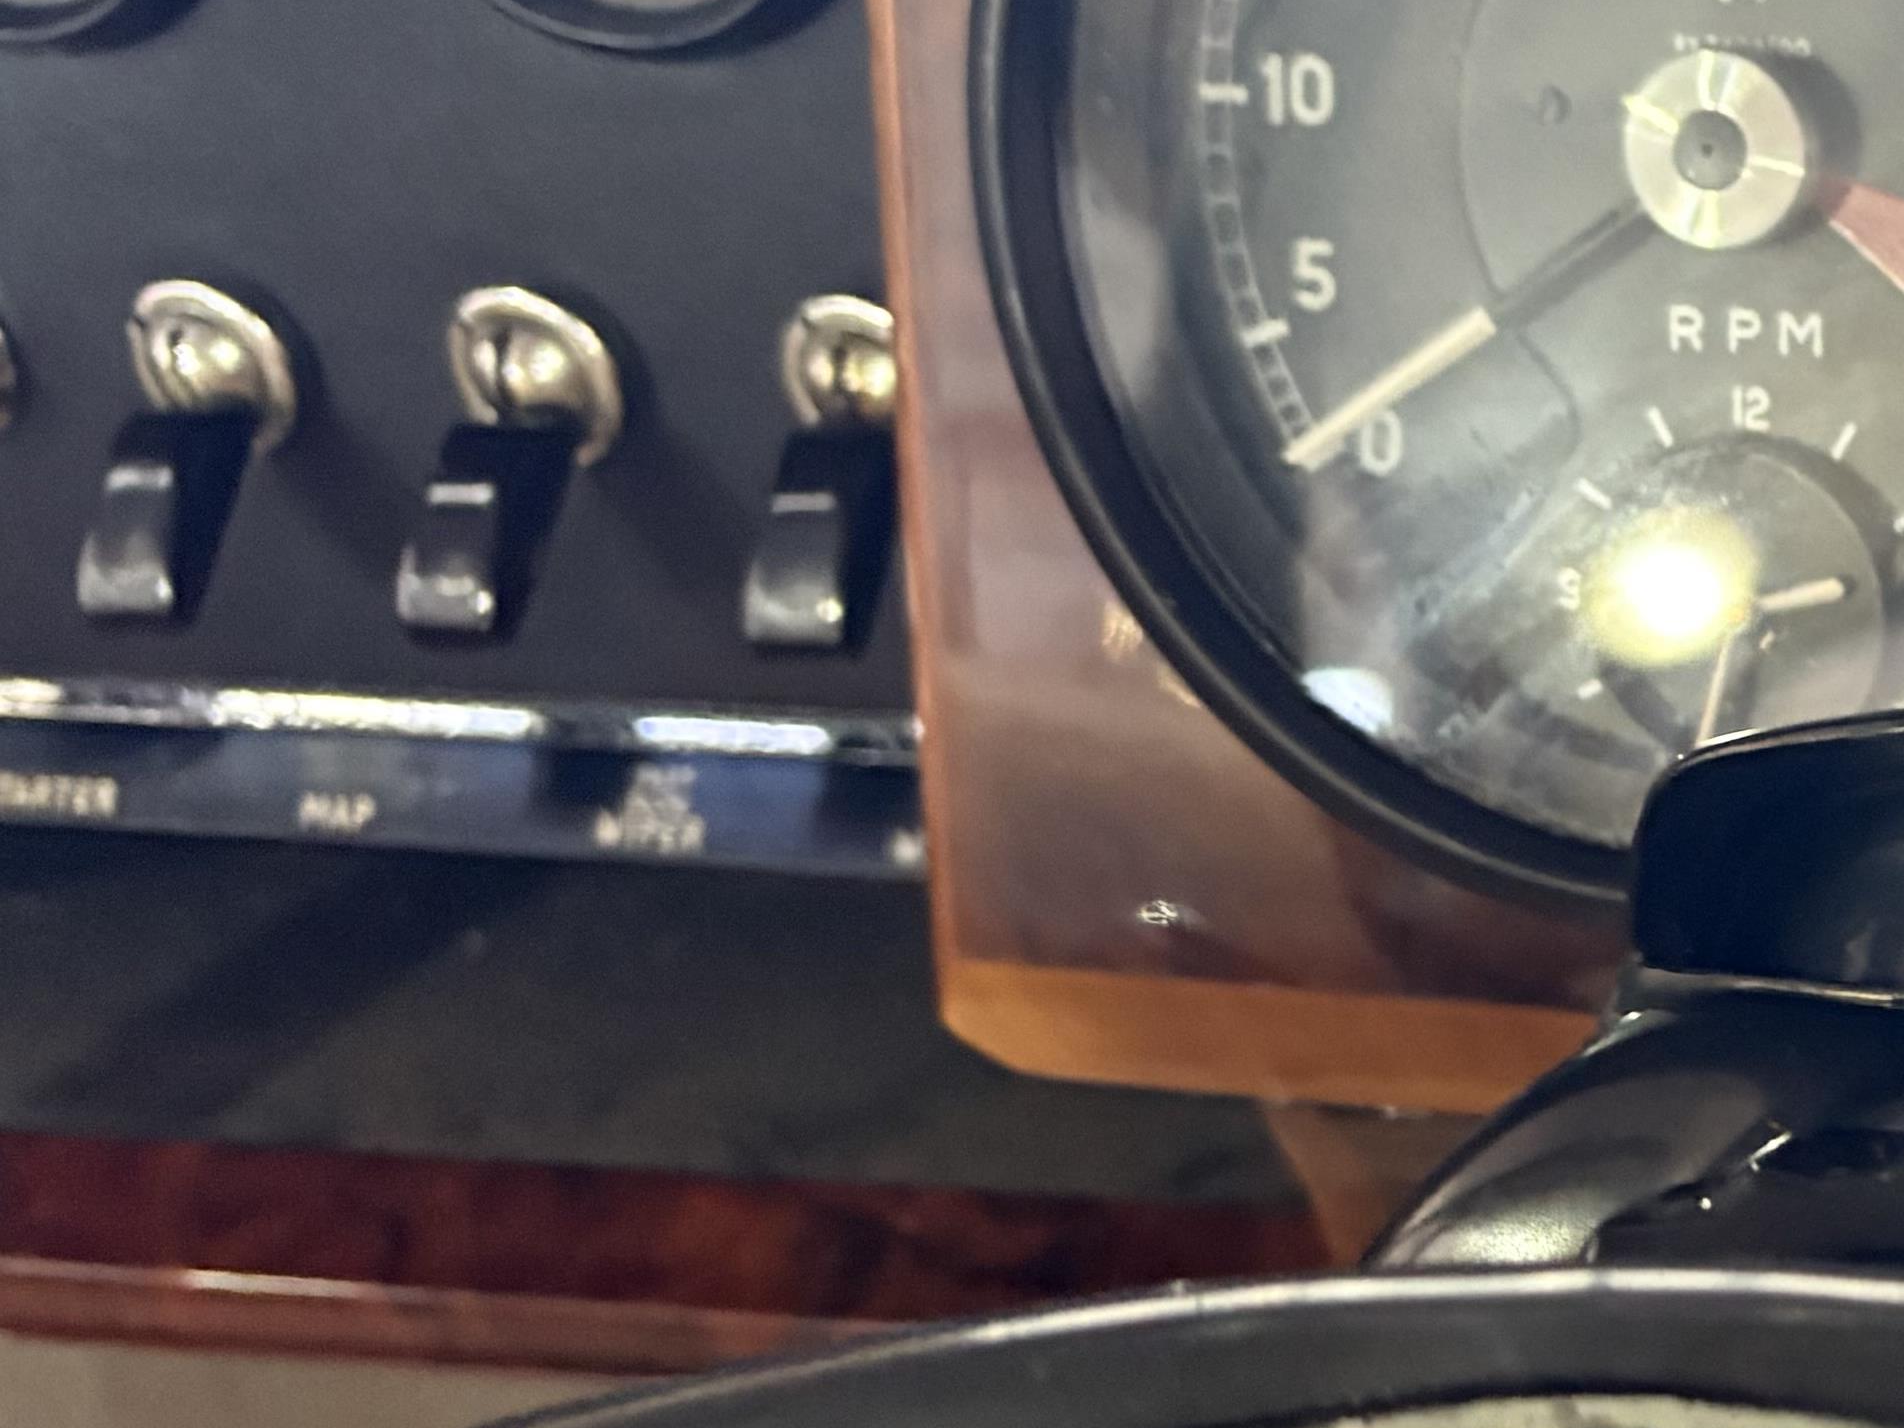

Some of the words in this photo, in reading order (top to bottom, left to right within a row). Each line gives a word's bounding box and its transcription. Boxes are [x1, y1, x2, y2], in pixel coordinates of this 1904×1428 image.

[1259, 51, 1336, 126] 10
[1290, 237, 1337, 312] 5
[1731, 387, 1771, 430] 12
